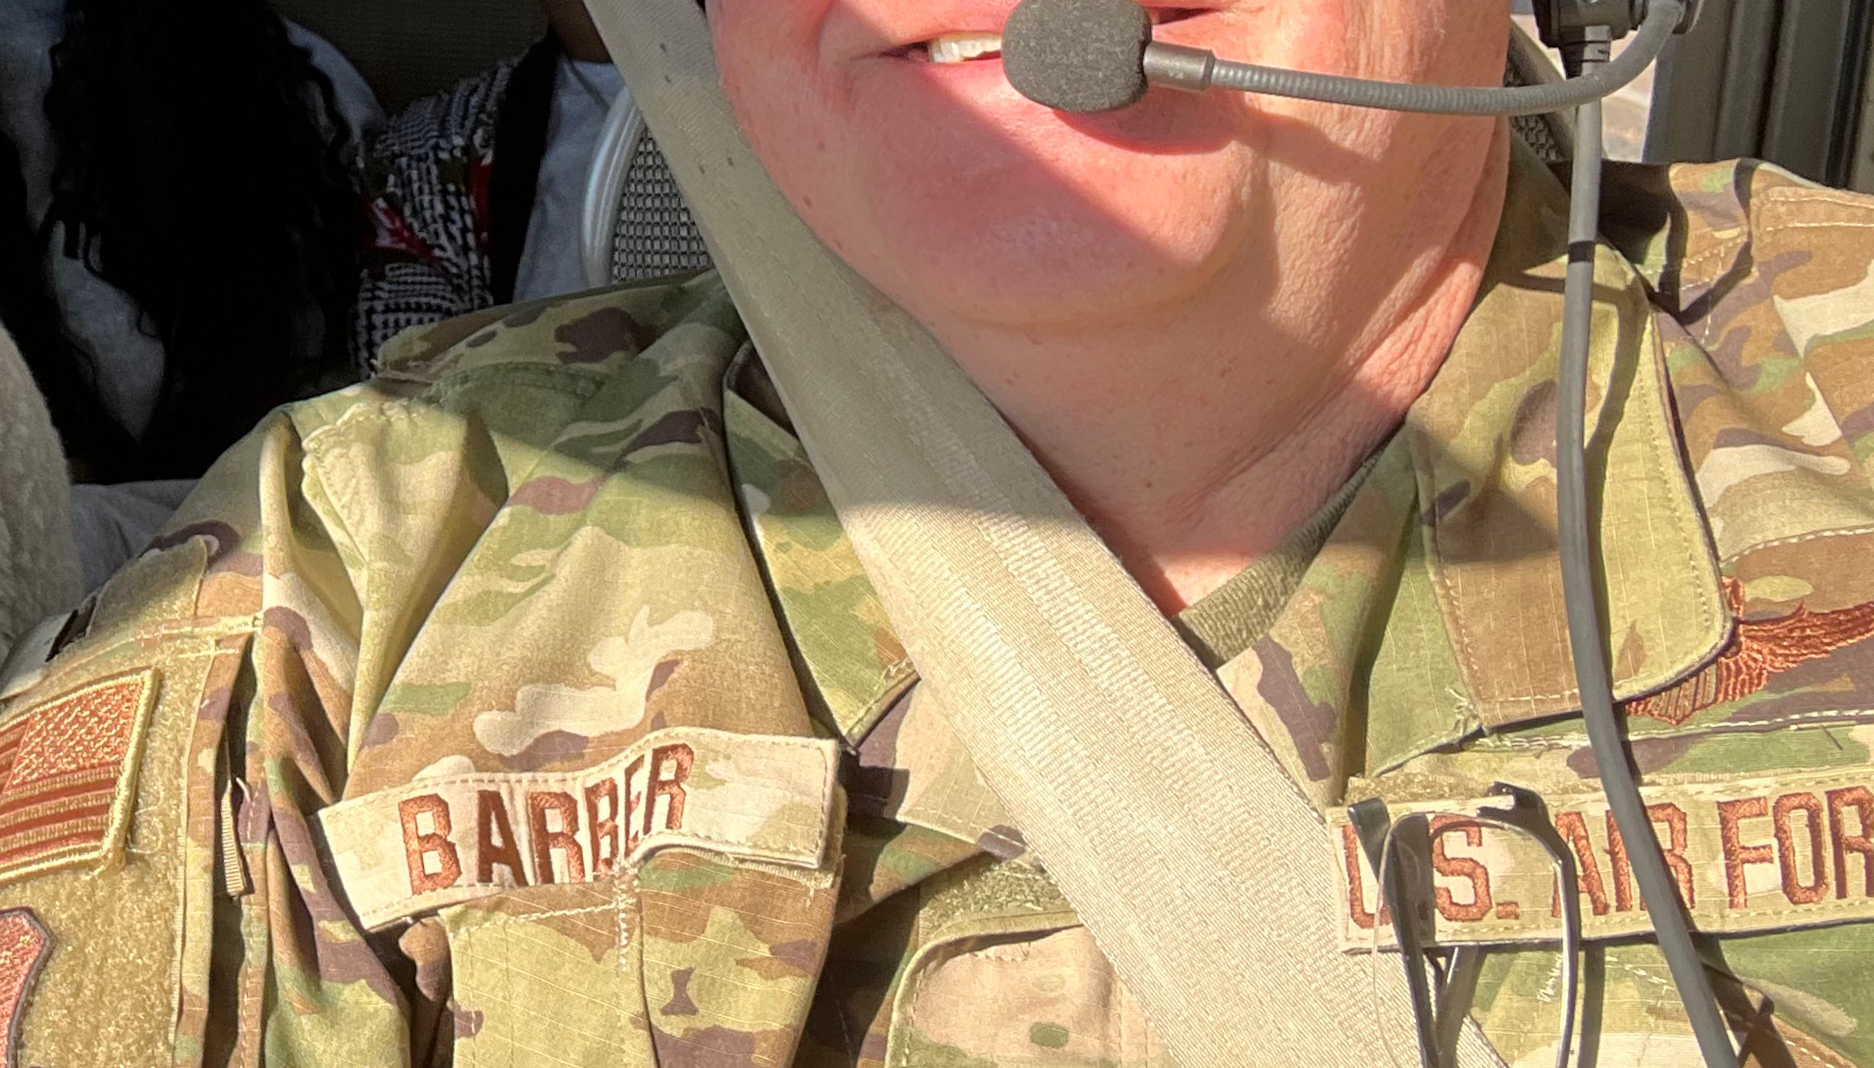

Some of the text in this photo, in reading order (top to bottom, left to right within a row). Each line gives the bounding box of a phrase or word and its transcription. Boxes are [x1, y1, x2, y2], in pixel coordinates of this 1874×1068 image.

[397, 742, 695, 895] BARBER
[1551, 801, 1696, 918] AIR
[1716, 785, 1874, 910] FOR
